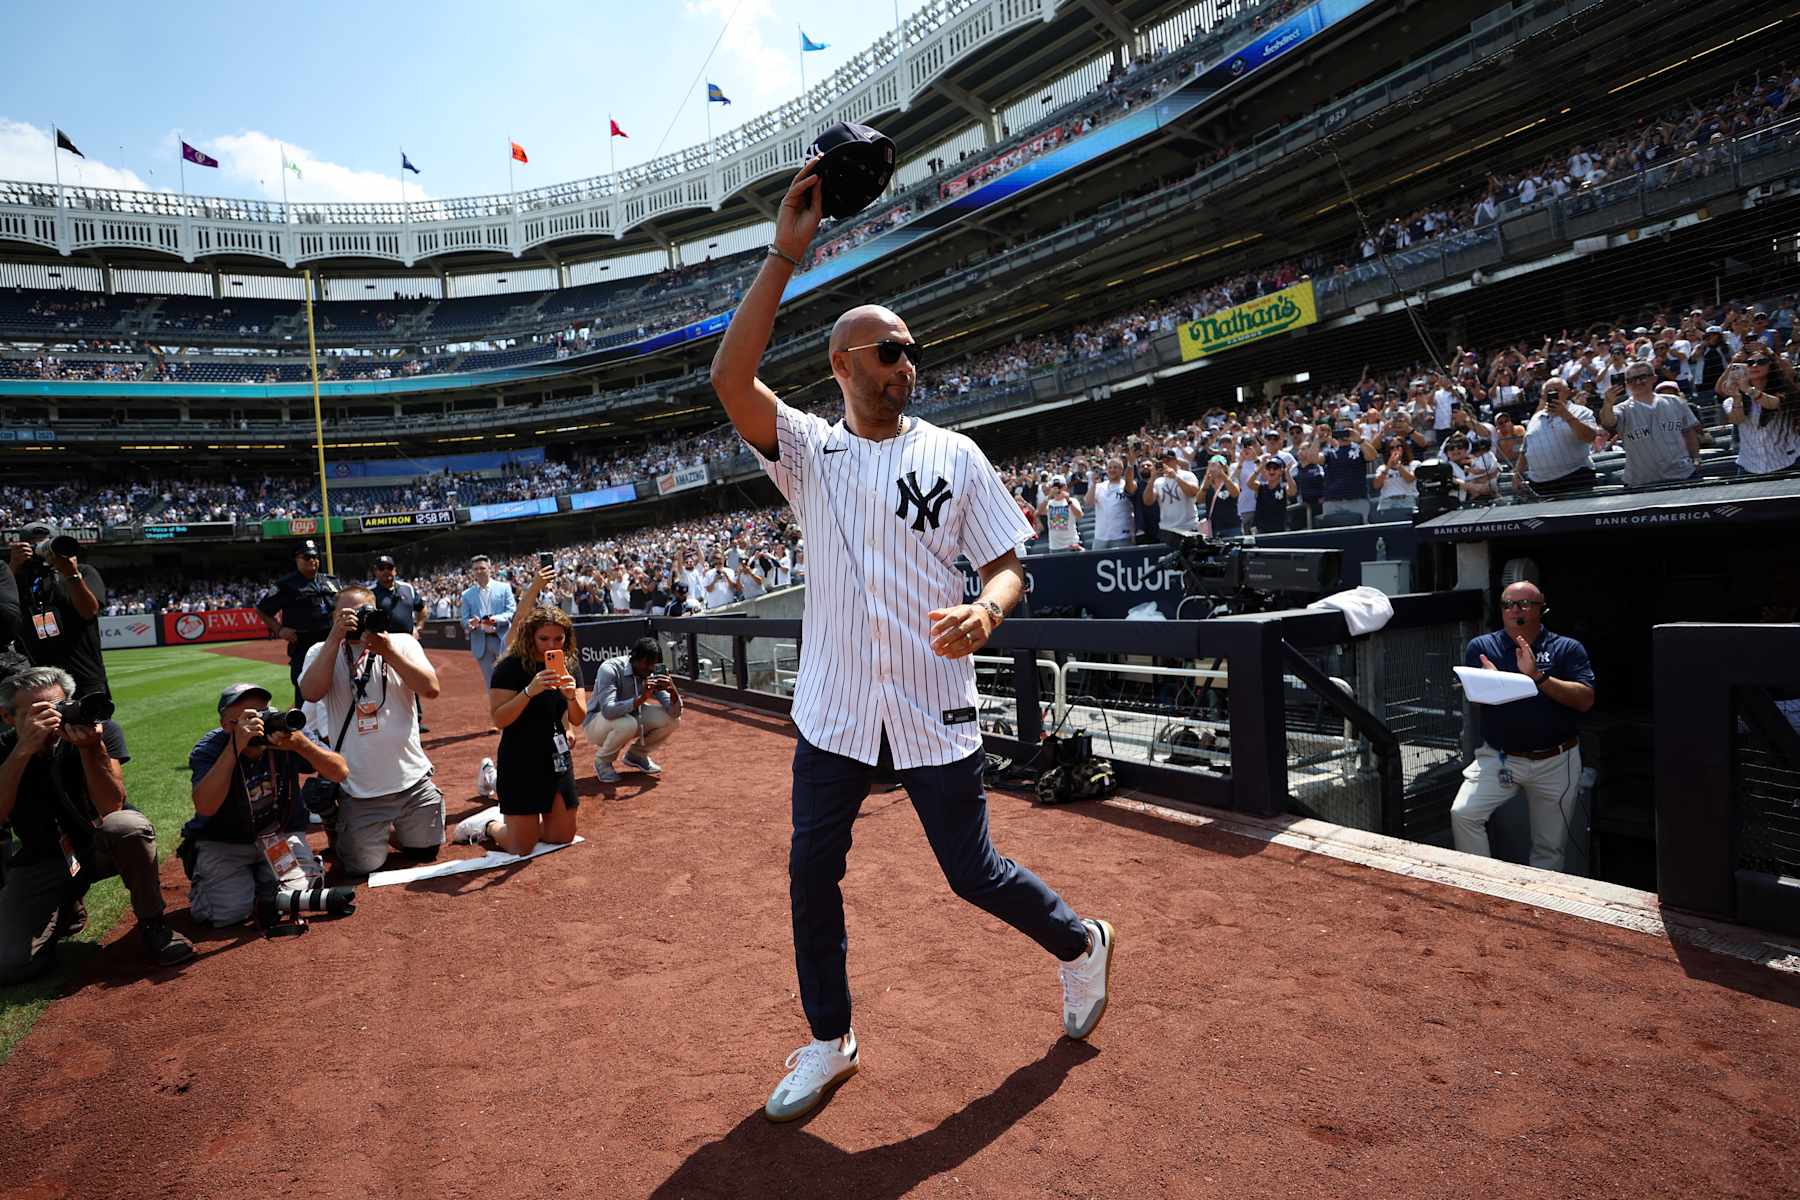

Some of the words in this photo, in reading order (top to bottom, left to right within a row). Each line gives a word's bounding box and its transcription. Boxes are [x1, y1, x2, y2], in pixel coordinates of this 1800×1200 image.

[1188, 295, 1301, 345] Nathan's
[896, 471, 953, 532] NY
[365, 516, 412, 526] ARMITRON
[415, 513, 438, 524] 12:58
[1594, 516, 1628, 526] BANK
[1631, 515, 1648, 524] OF
[1649, 511, 1712, 523] AMERICA
[1434, 526, 1460, 535] BANK
[1462, 526, 1473, 534] OF
[1475, 522, 1521, 533] AMERICA
